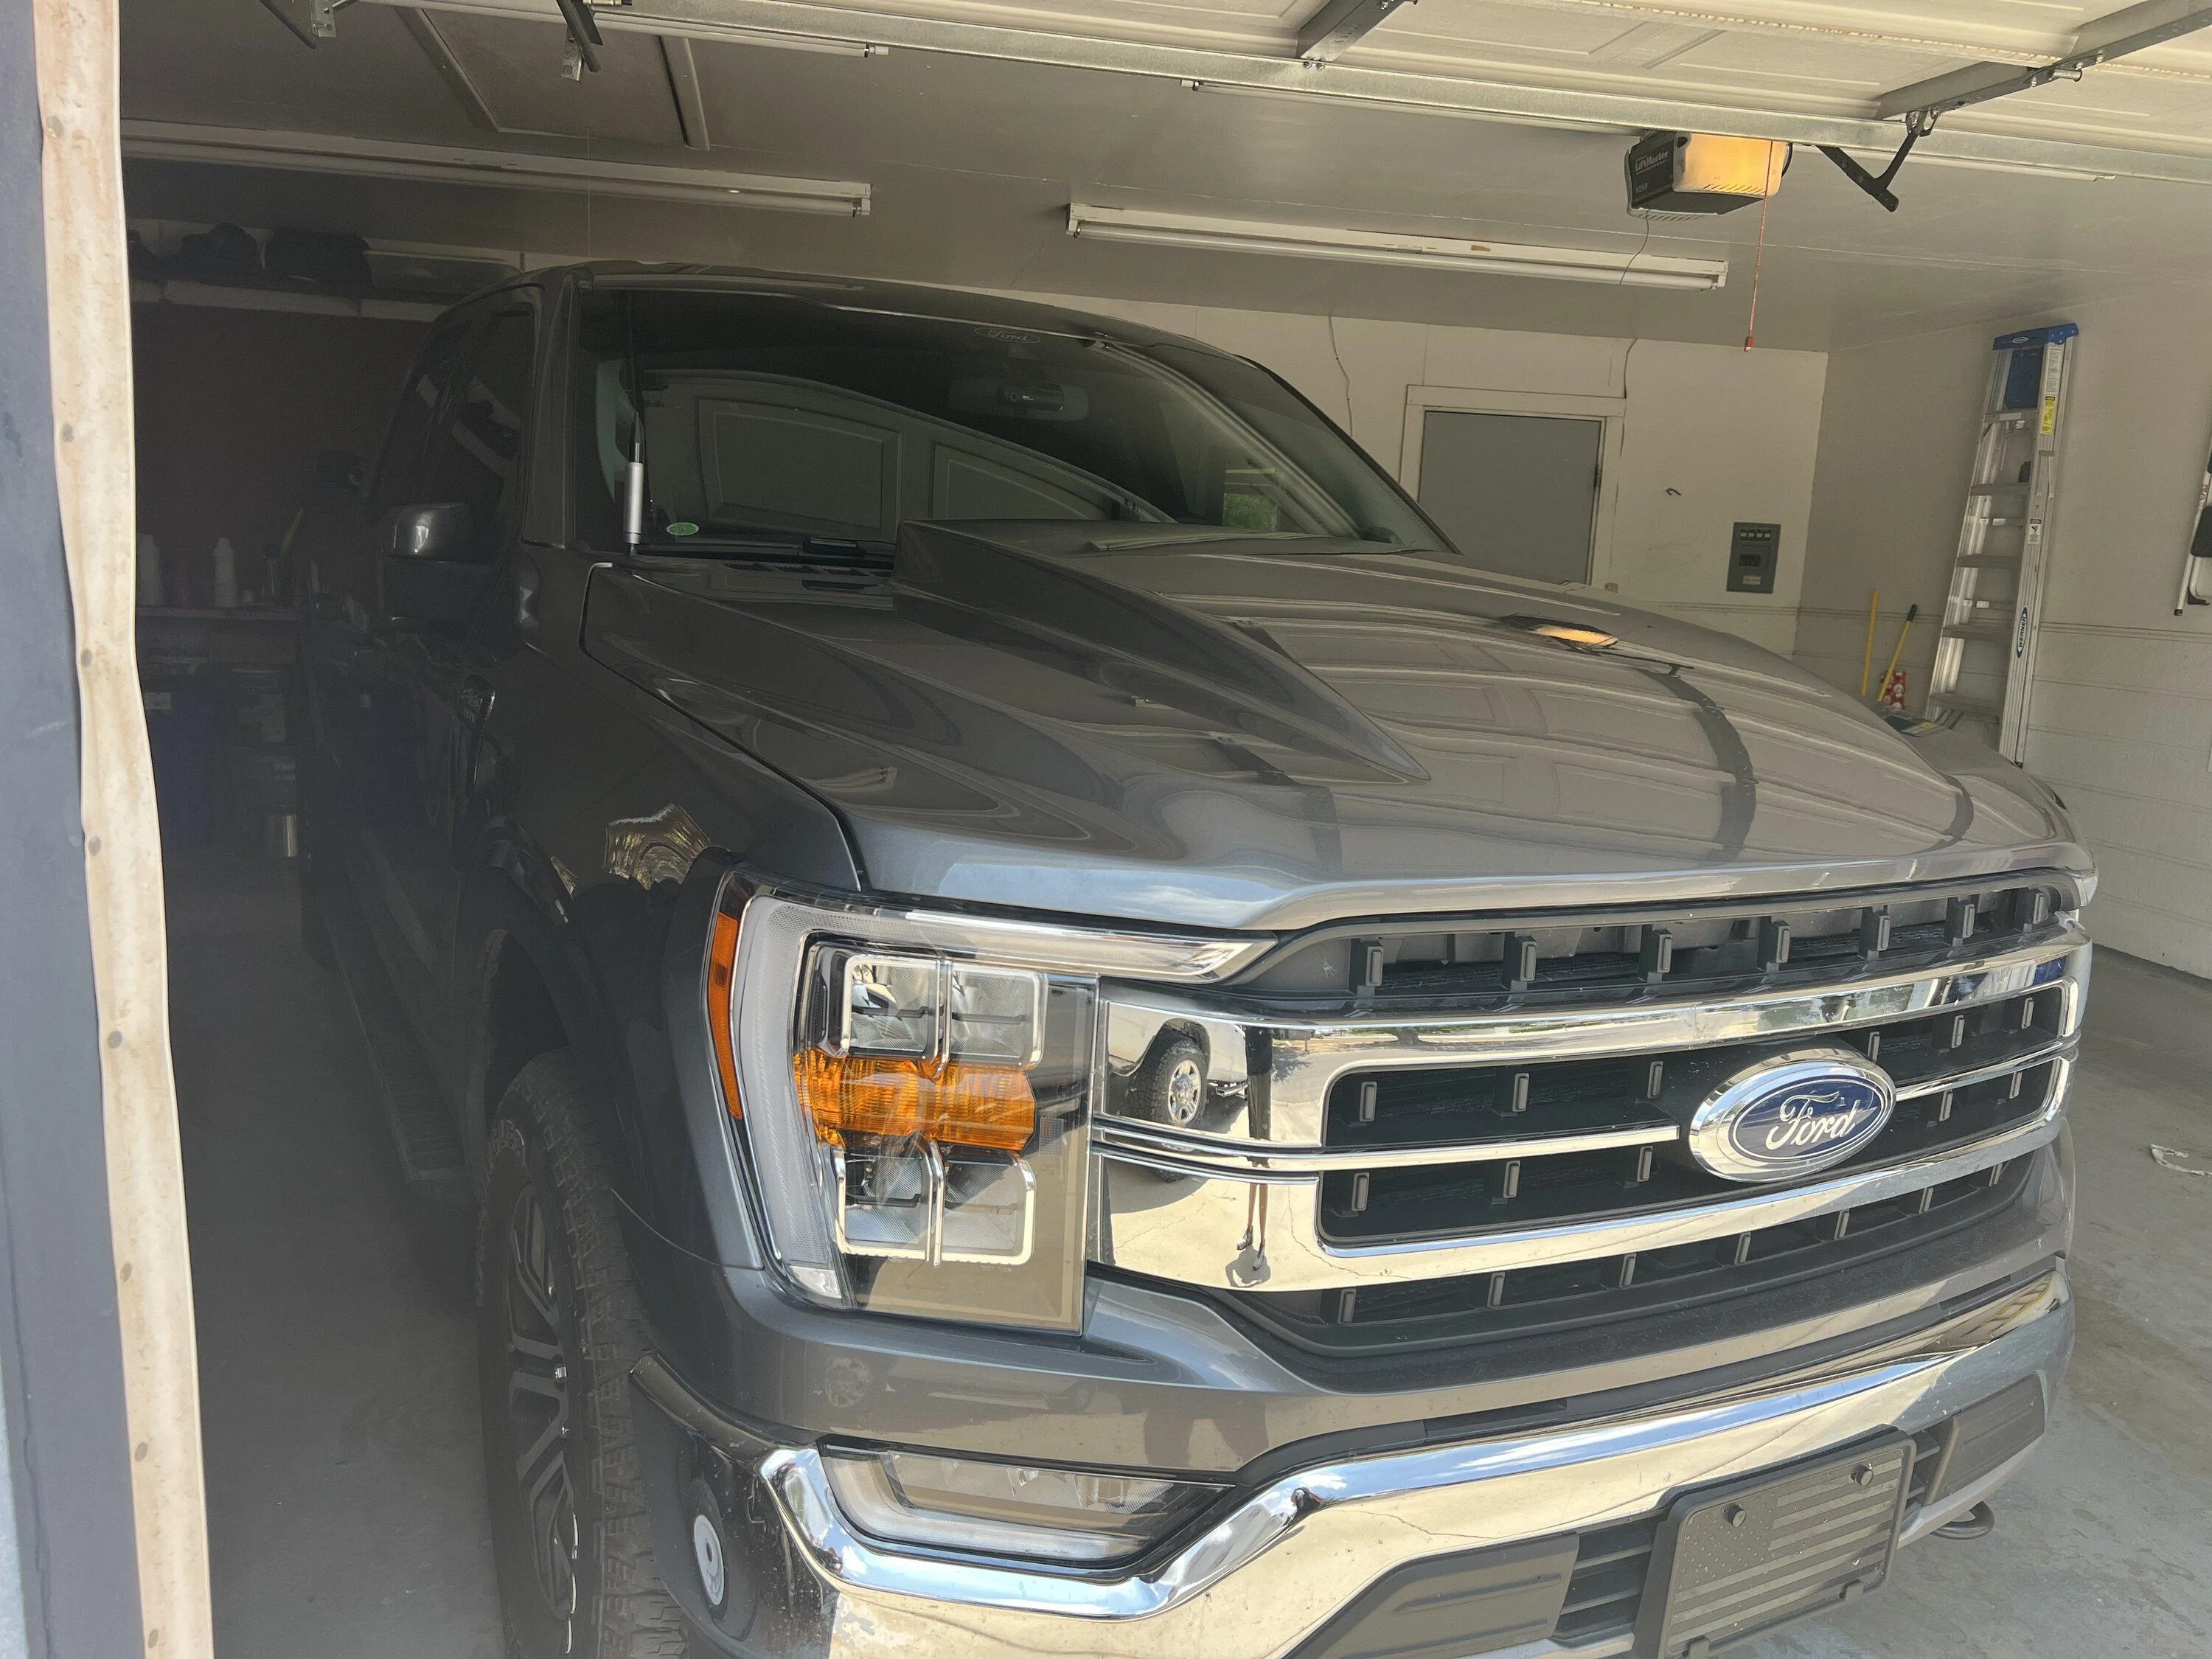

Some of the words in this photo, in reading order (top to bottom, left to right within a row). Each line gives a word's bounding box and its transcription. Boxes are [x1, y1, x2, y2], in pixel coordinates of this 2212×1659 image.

[987, 329, 1029, 342] Ford
[2018, 616, 2026, 648] WERNER
[1765, 1091, 1860, 1150] Ford
